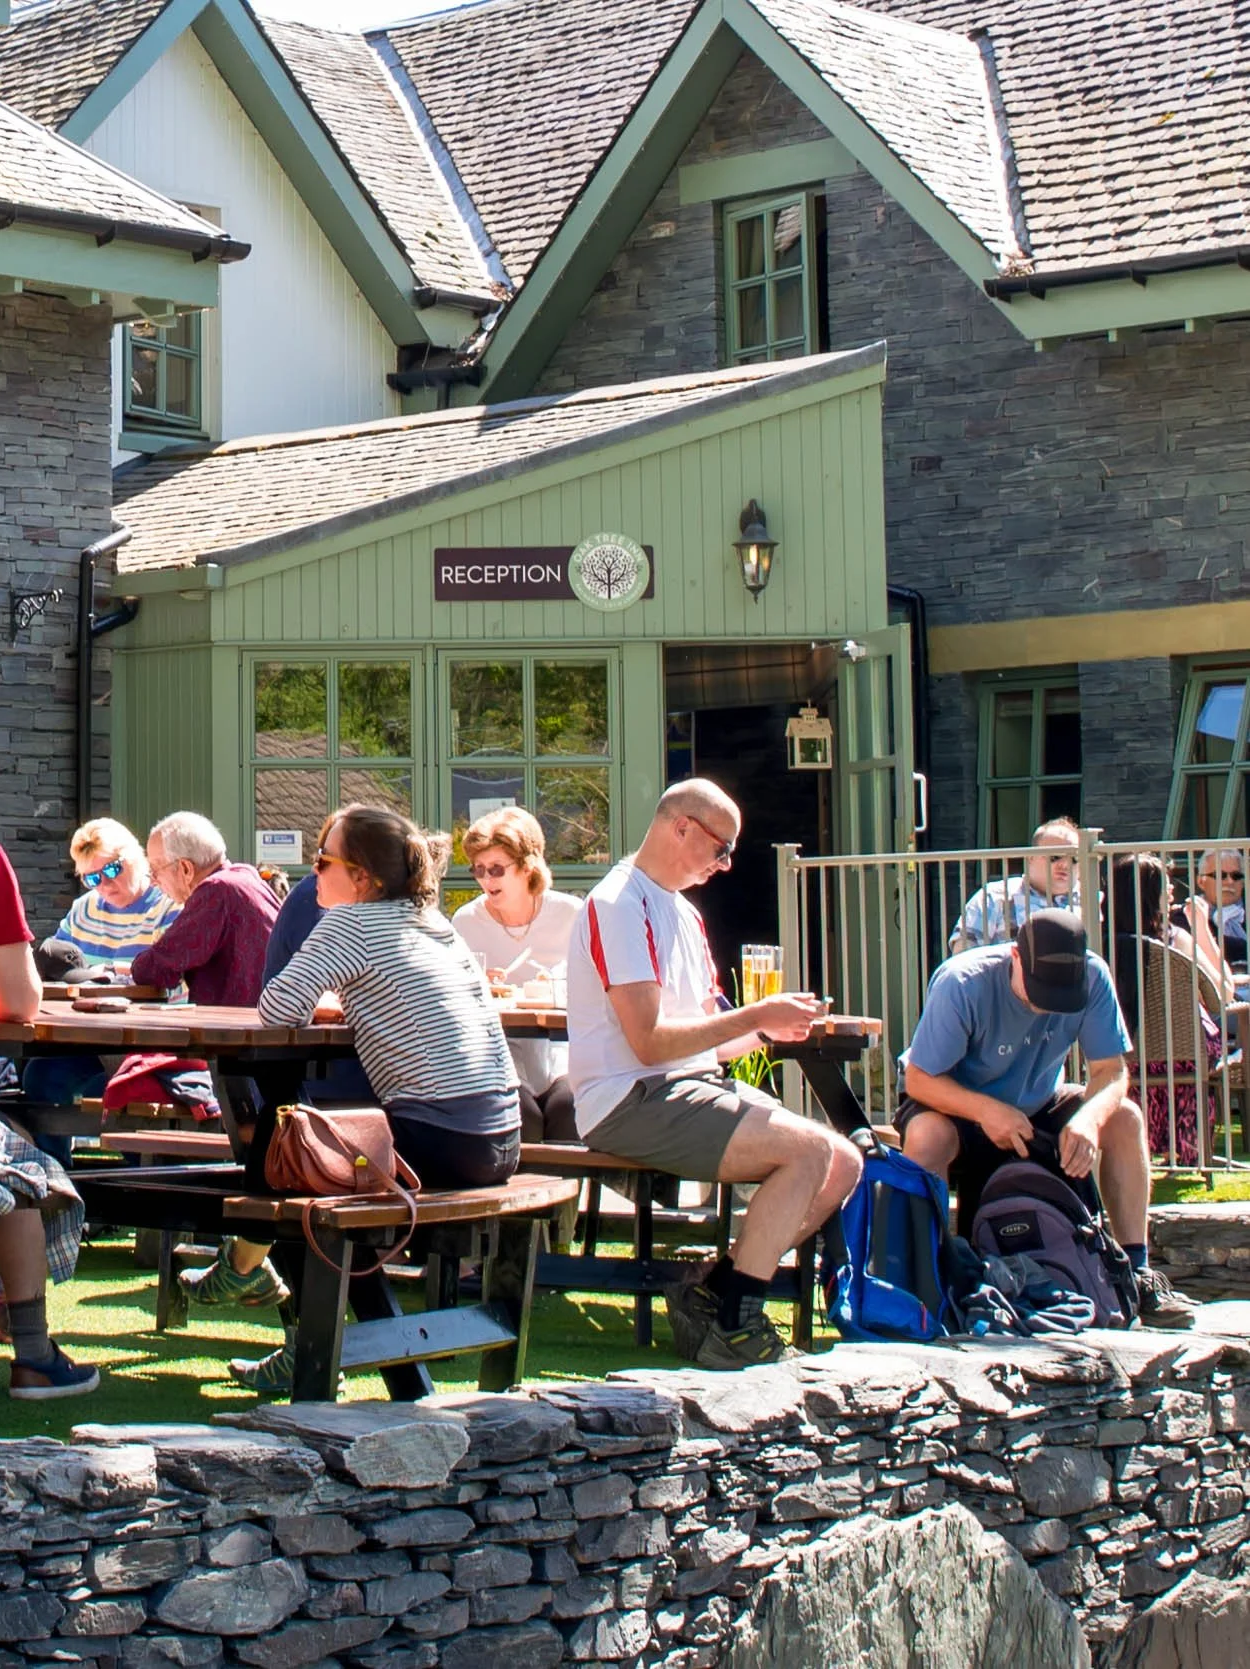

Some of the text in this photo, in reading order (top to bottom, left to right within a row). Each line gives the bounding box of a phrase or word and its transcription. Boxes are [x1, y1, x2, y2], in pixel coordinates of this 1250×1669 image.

[573, 533, 644, 563] OAK TREE INN
[441, 565, 562, 584] RECEPTION
